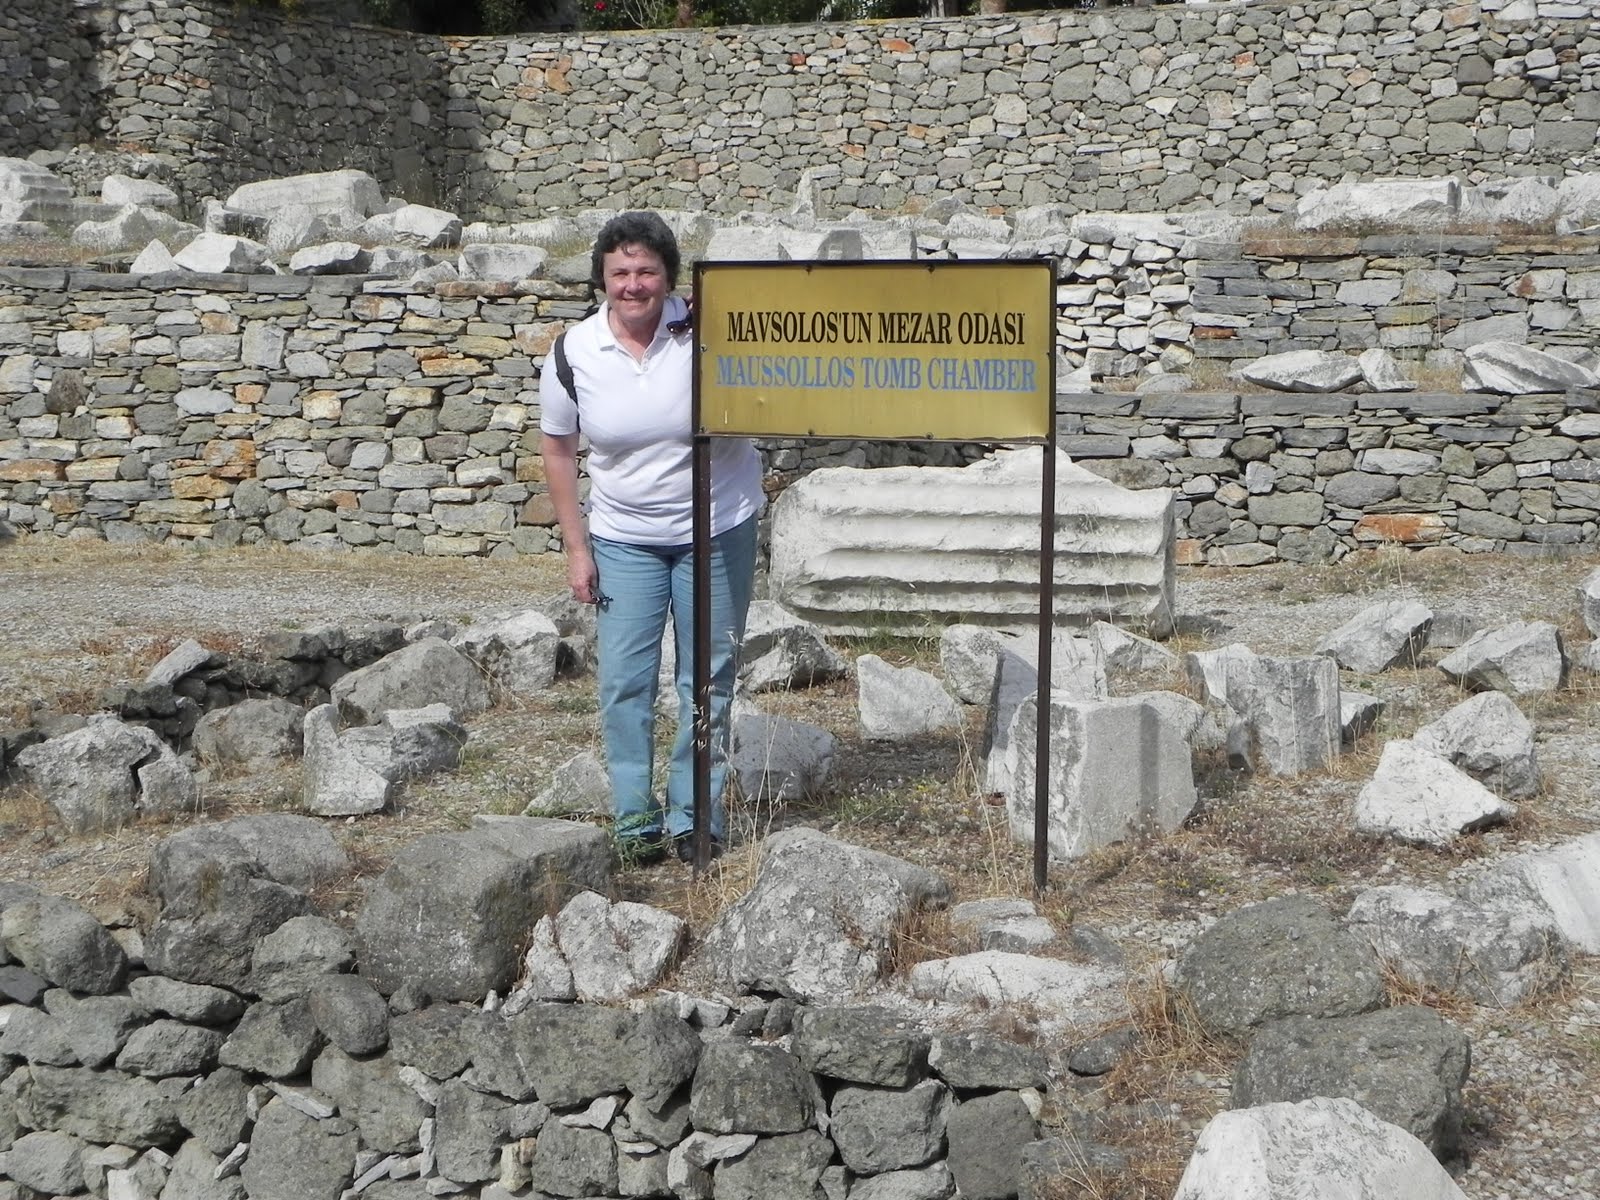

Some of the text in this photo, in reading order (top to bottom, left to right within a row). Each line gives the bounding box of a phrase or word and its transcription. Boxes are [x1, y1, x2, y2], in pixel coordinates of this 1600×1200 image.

[727, 311, 873, 343] MAVSOLOS'UN
[878, 312, 952, 344] MEZAR
[716, 355, 1037, 391] MAUSSOLLOS TOMB CHAMBER
